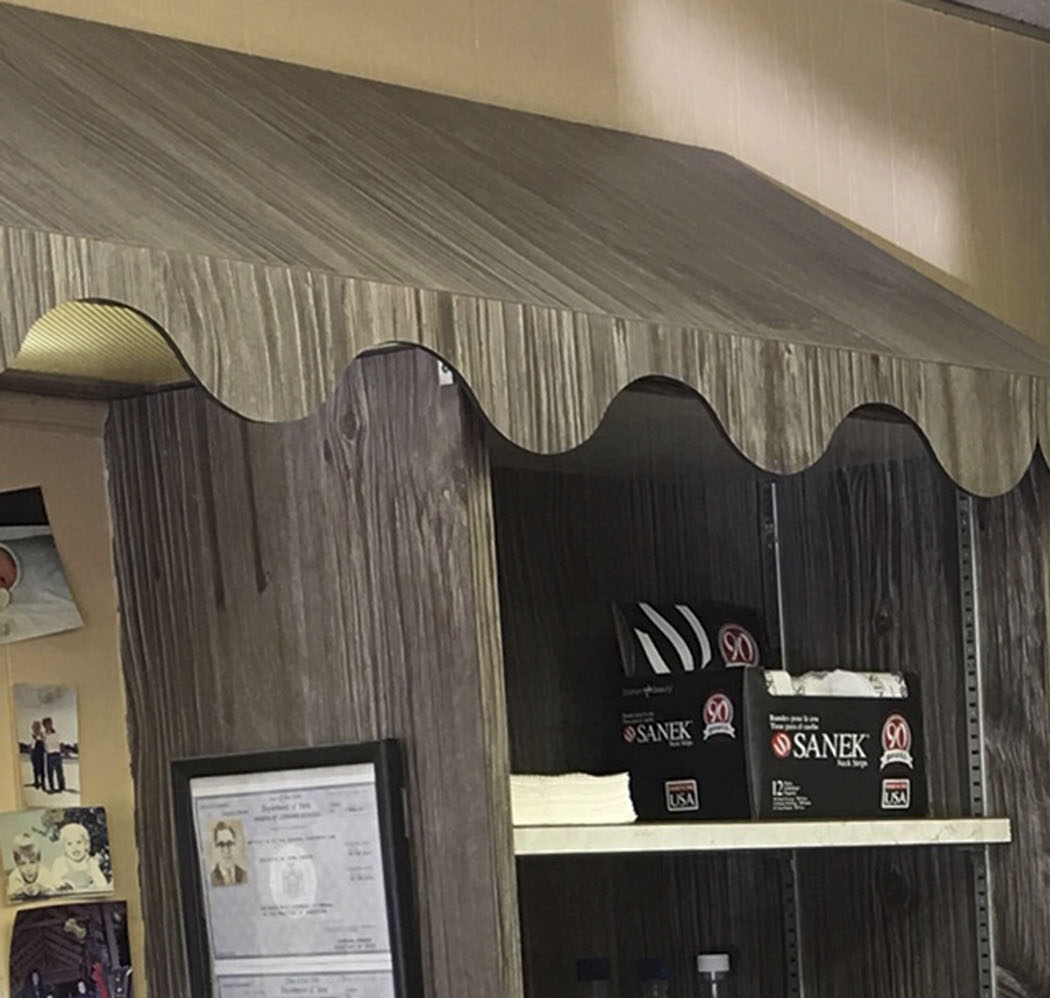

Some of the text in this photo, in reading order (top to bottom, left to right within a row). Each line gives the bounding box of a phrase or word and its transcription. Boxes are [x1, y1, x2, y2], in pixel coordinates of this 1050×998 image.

[723, 631, 753, 661] 90
[708, 700, 729, 723] 90
[636, 720, 692, 743] SANEK
[886, 722, 907, 749] 90
[792, 732, 867, 759] SANEK
[772, 780, 784, 796] 12
[885, 791, 907, 805] USA
